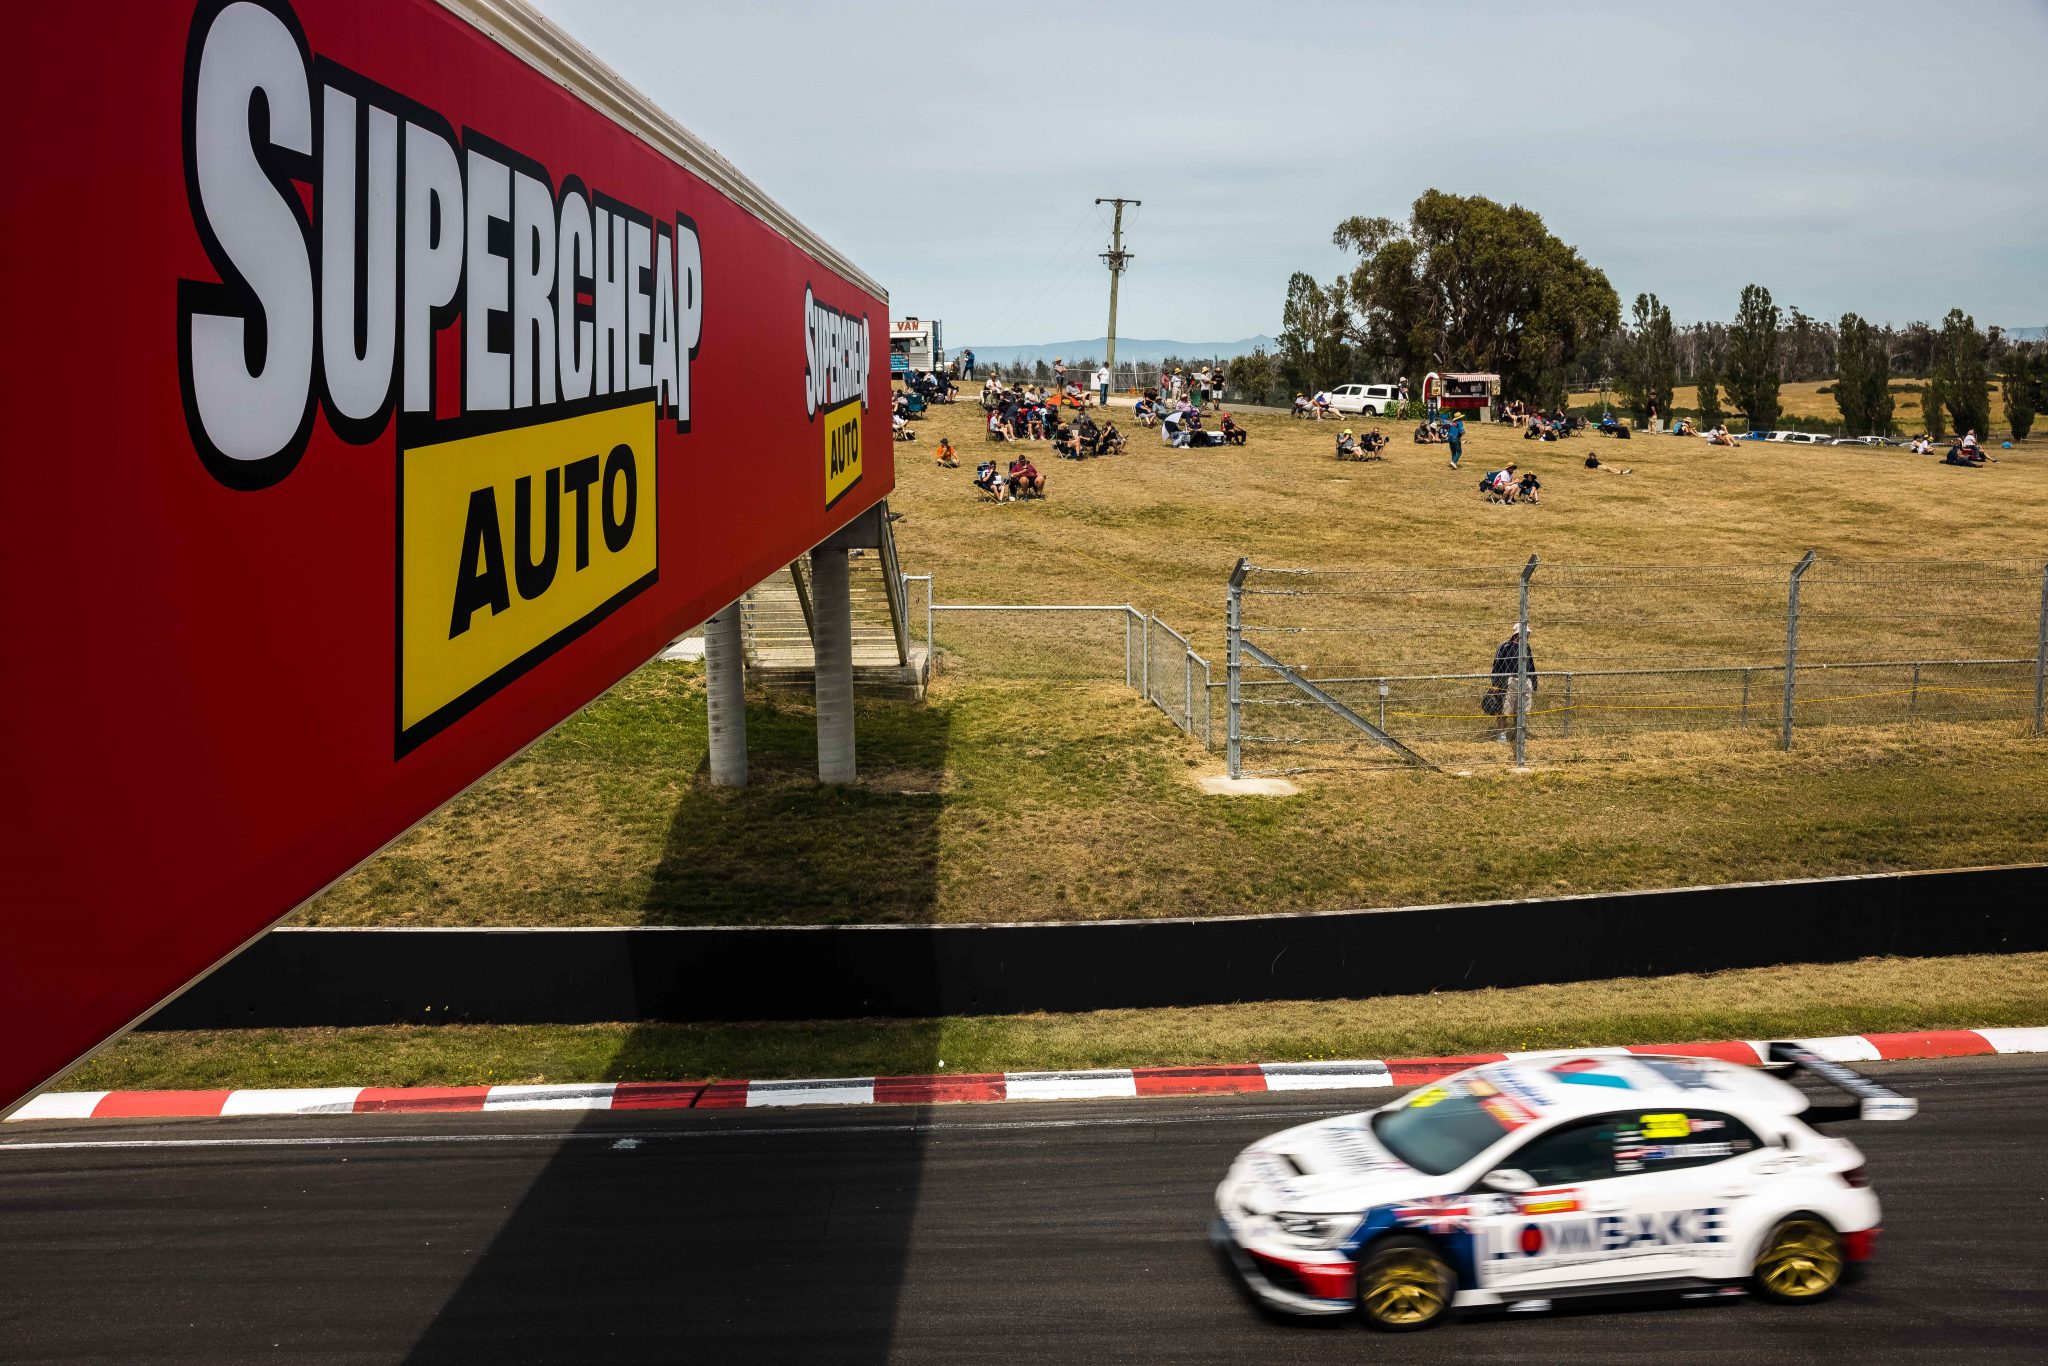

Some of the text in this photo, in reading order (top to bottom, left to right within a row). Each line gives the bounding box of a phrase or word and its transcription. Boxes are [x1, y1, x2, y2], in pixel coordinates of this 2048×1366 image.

[190, 1, 702, 462] SUPERCHEAP
[804, 287, 870, 416] SUPERCHEAP
[897, 321, 919, 331] VAN
[830, 418, 858, 480] AUTO
[447, 443, 637, 641] AUTO
